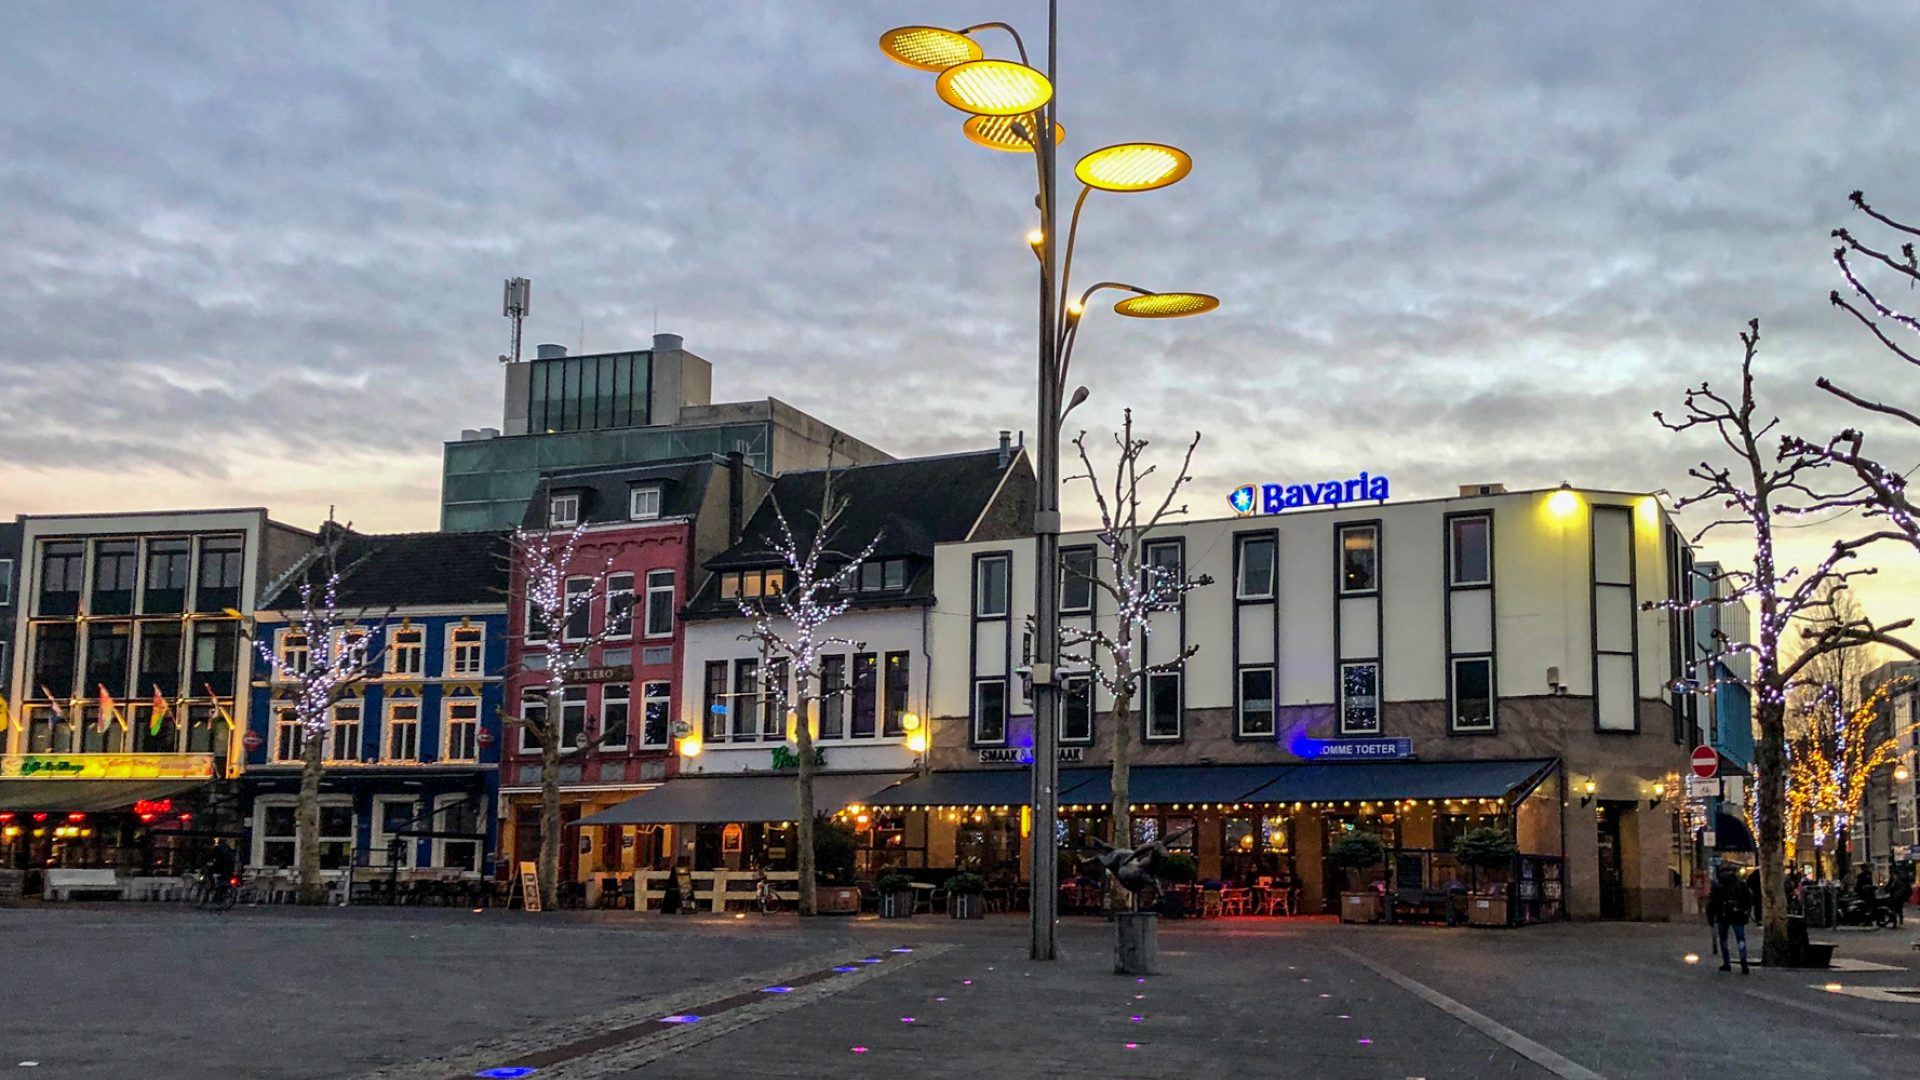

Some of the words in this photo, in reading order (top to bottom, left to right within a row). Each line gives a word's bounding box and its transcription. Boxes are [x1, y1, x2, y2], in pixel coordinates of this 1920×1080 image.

[1262, 471, 1389, 513] Bavaria
[573, 669, 613, 680] BOLERO
[1355, 744, 1396, 754] TOETER
[981, 749, 1018, 761] SMAAK
